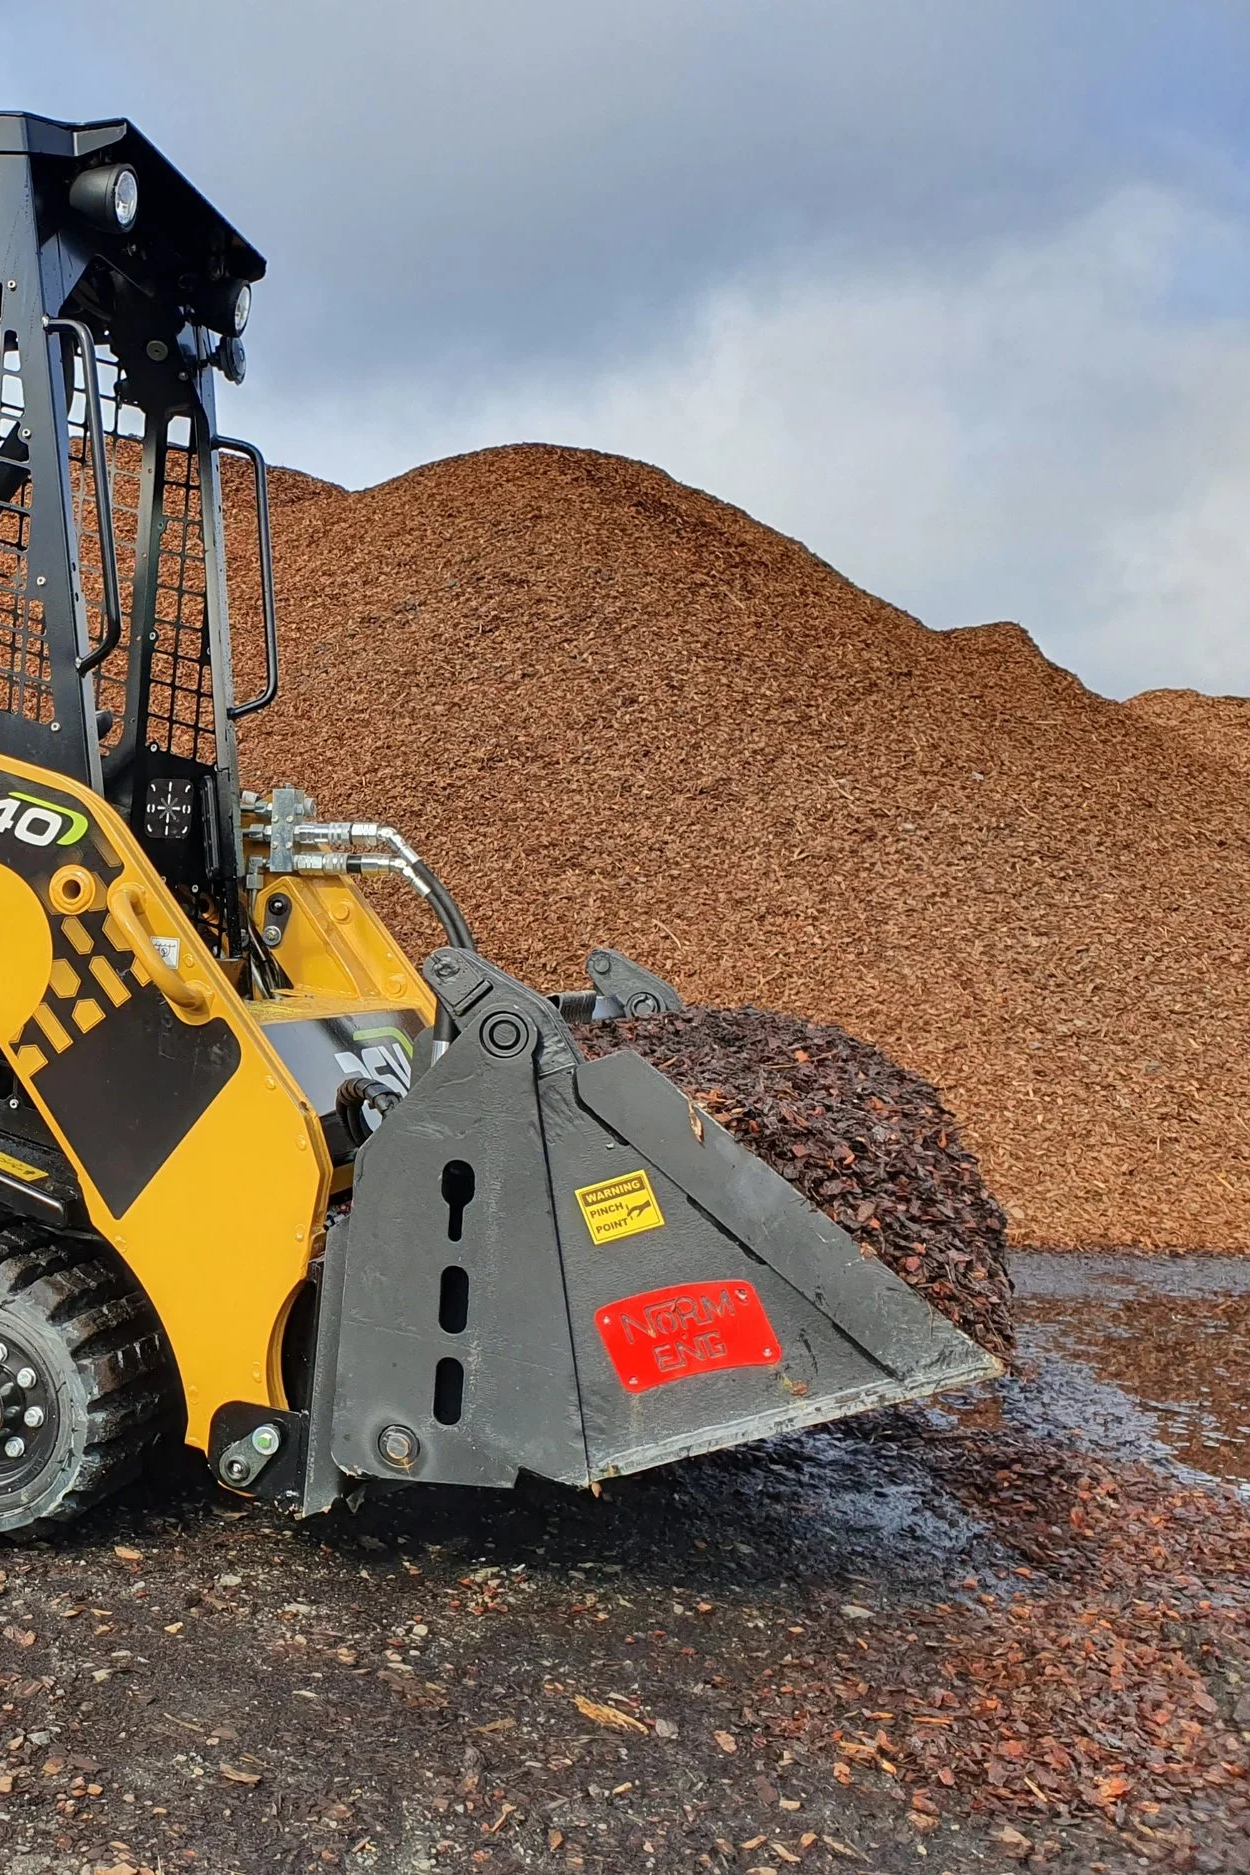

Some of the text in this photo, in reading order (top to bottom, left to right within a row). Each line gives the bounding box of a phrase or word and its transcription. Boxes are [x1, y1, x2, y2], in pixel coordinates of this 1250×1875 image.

[585, 1180, 640, 1203] WARNING
[590, 1202, 624, 1219] PINCH
[596, 1217, 629, 1234] POINT
[620, 1291, 735, 1345] NORM
[654, 1332, 726, 1371] ENG
